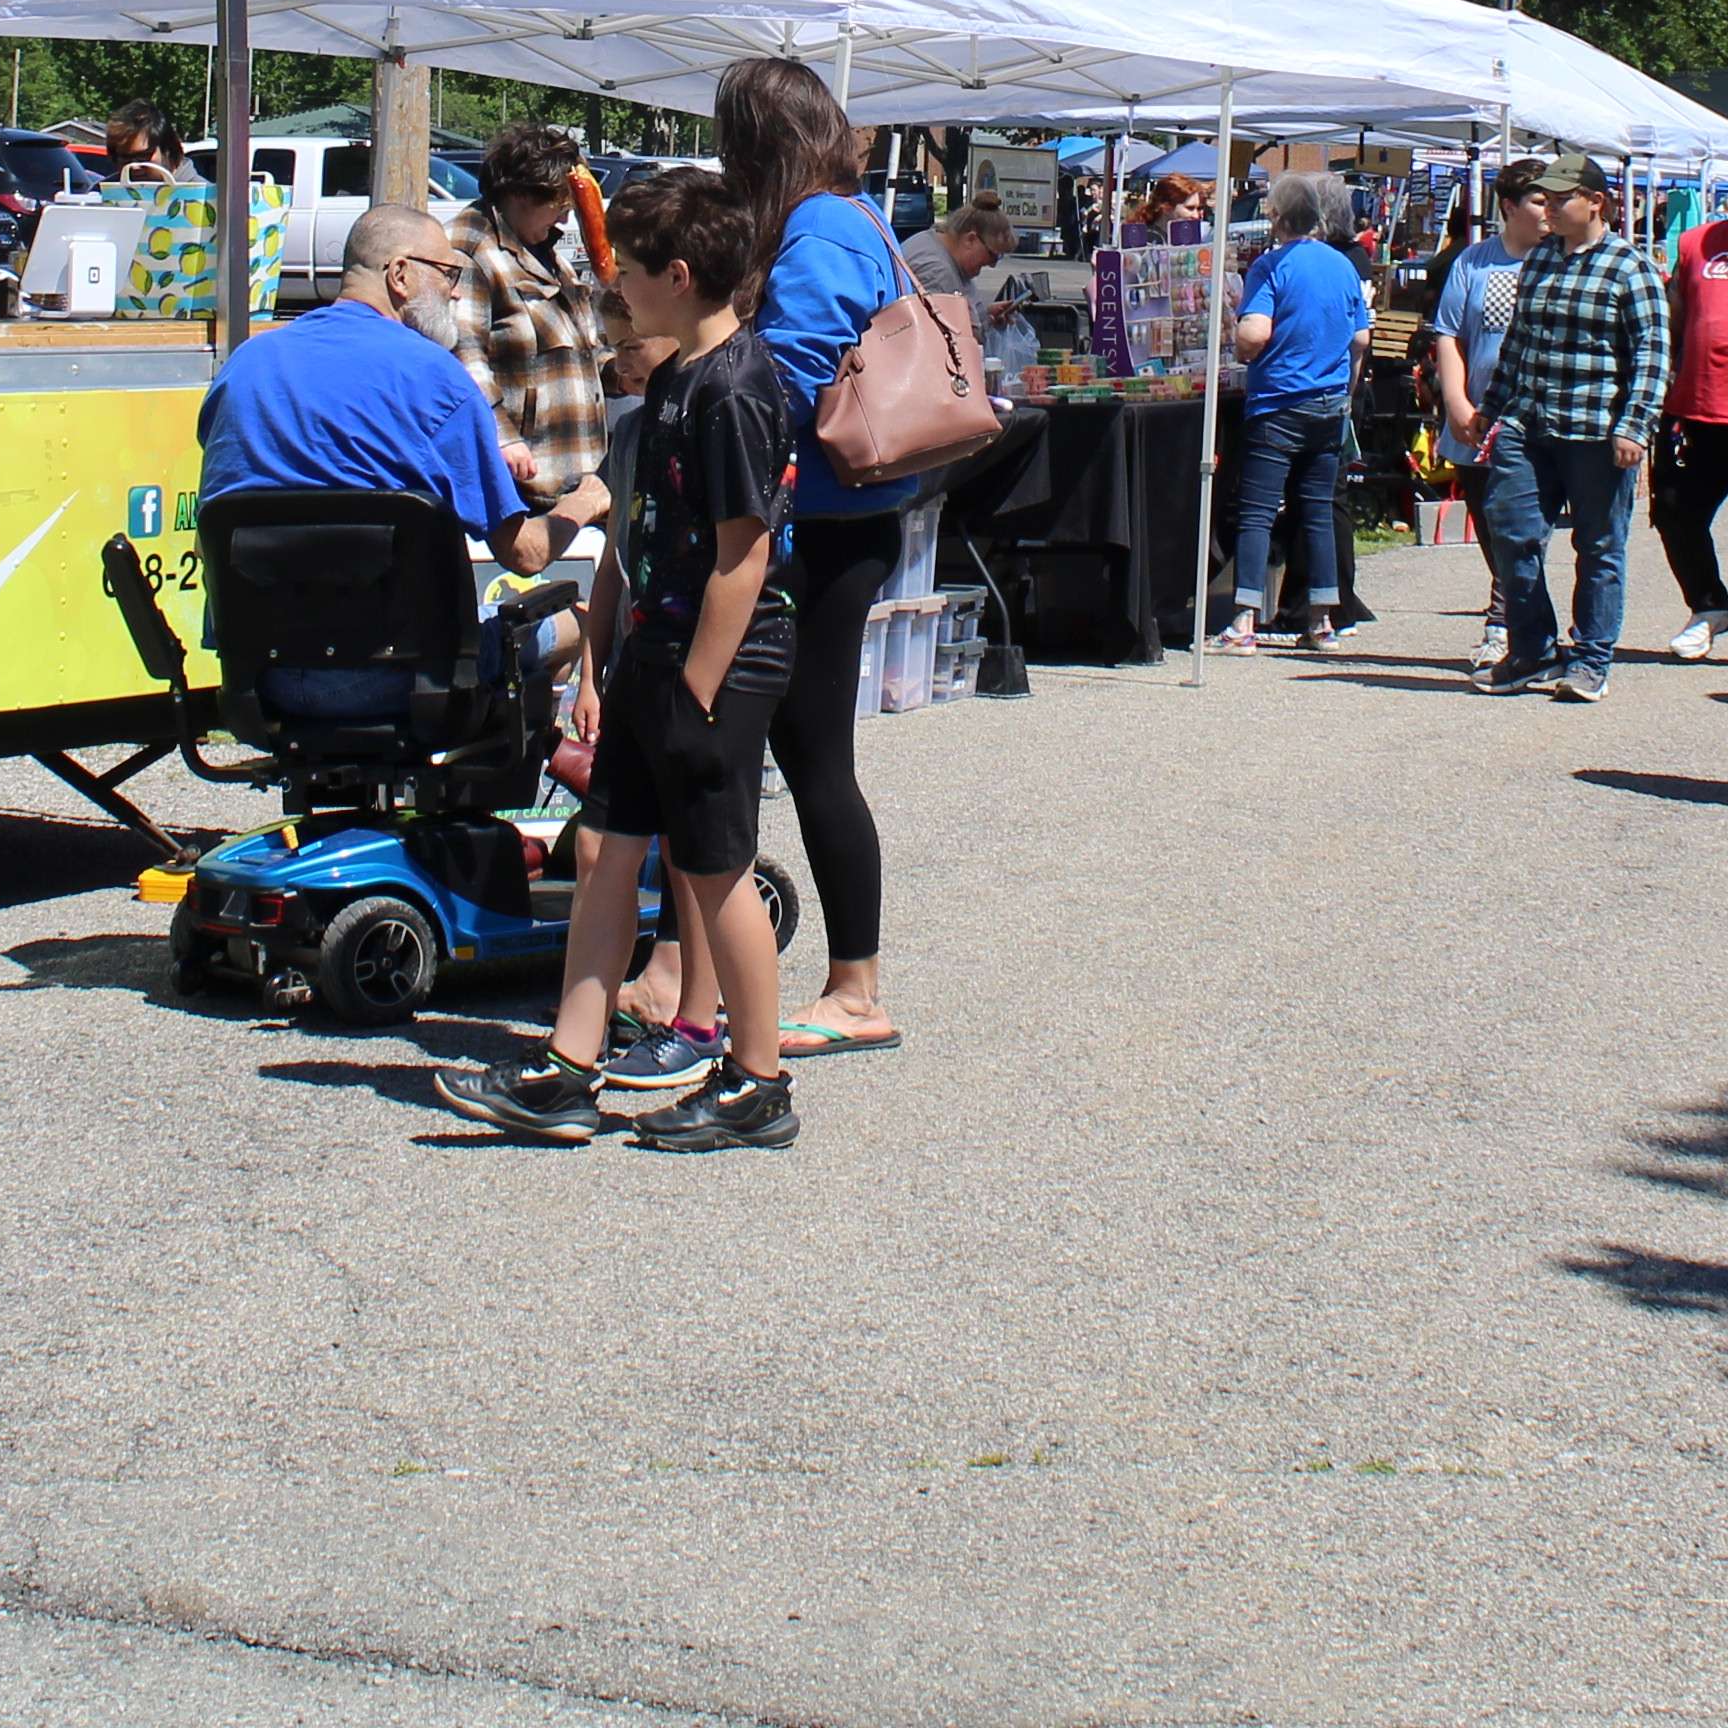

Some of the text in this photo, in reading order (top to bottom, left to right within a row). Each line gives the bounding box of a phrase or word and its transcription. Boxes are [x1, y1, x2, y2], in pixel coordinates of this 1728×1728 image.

[1023, 201, 1038, 216] Club
[1101, 271, 1118, 373] SCENTSY
[174, 490, 199, 531] AL
